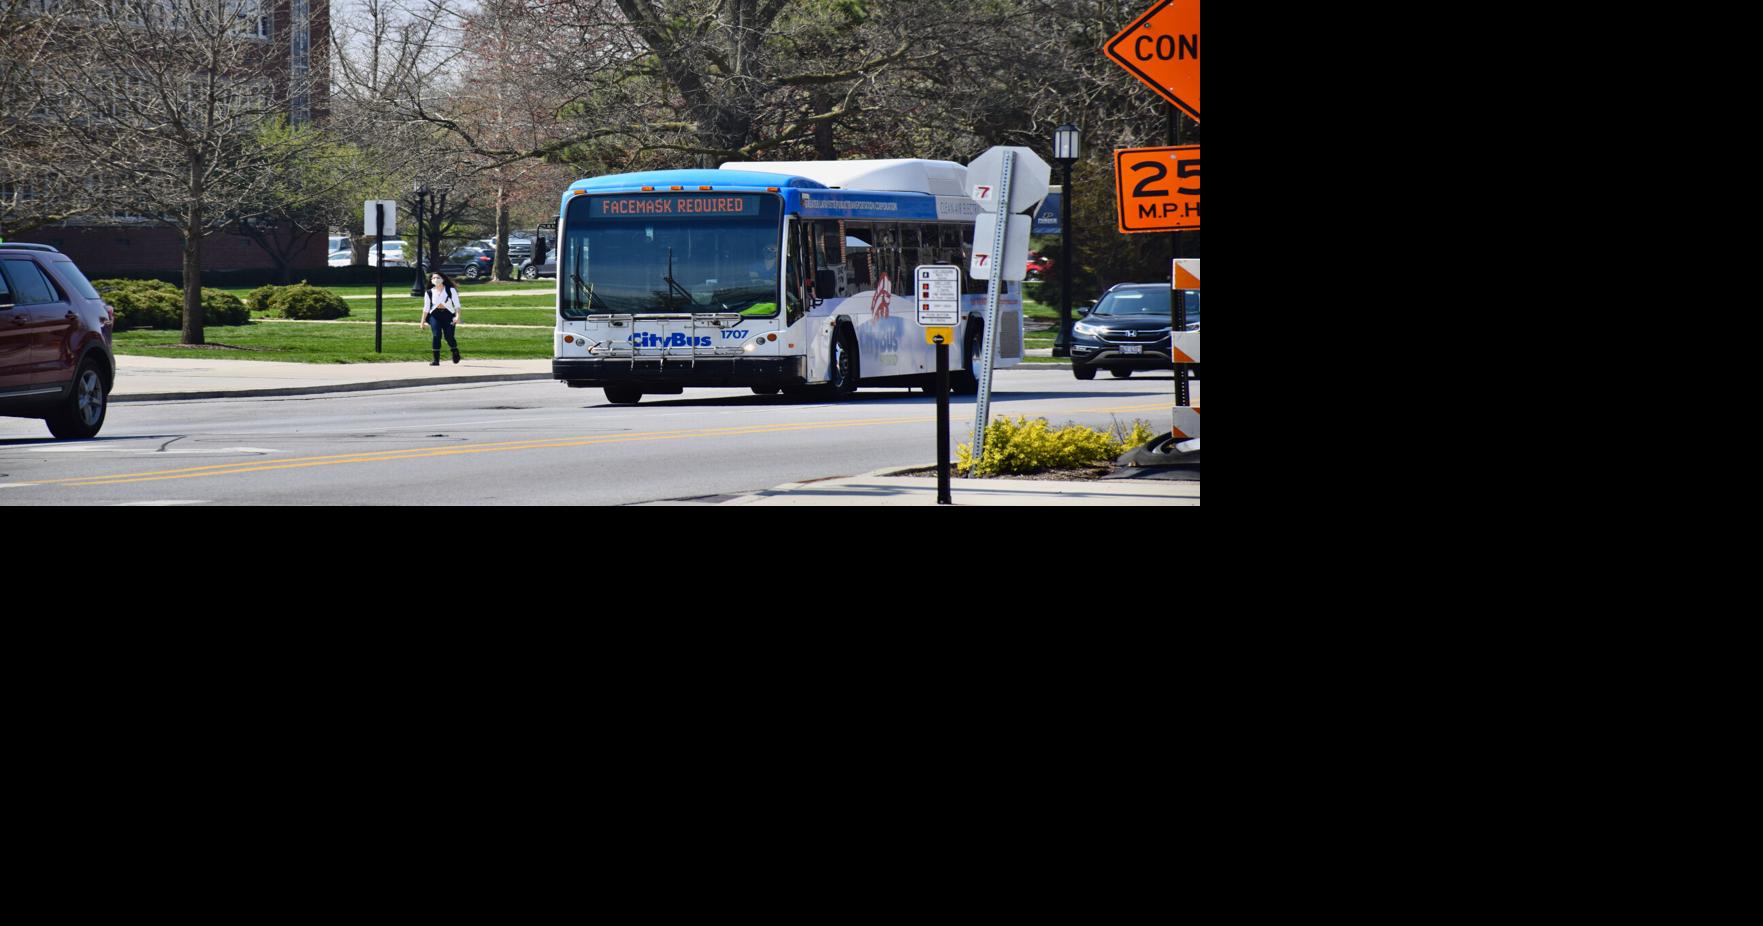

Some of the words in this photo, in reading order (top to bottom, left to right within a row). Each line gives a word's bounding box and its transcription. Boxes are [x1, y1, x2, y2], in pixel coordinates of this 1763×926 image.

[1135, 34, 1198, 61] CON
[1130, 159, 1200, 197] 25
[603, 200, 672, 214] FACEMASK
[677, 198, 743, 212] REQUIRED
[628, 331, 711, 347] CityBus
[721, 330, 749, 339] 1707
